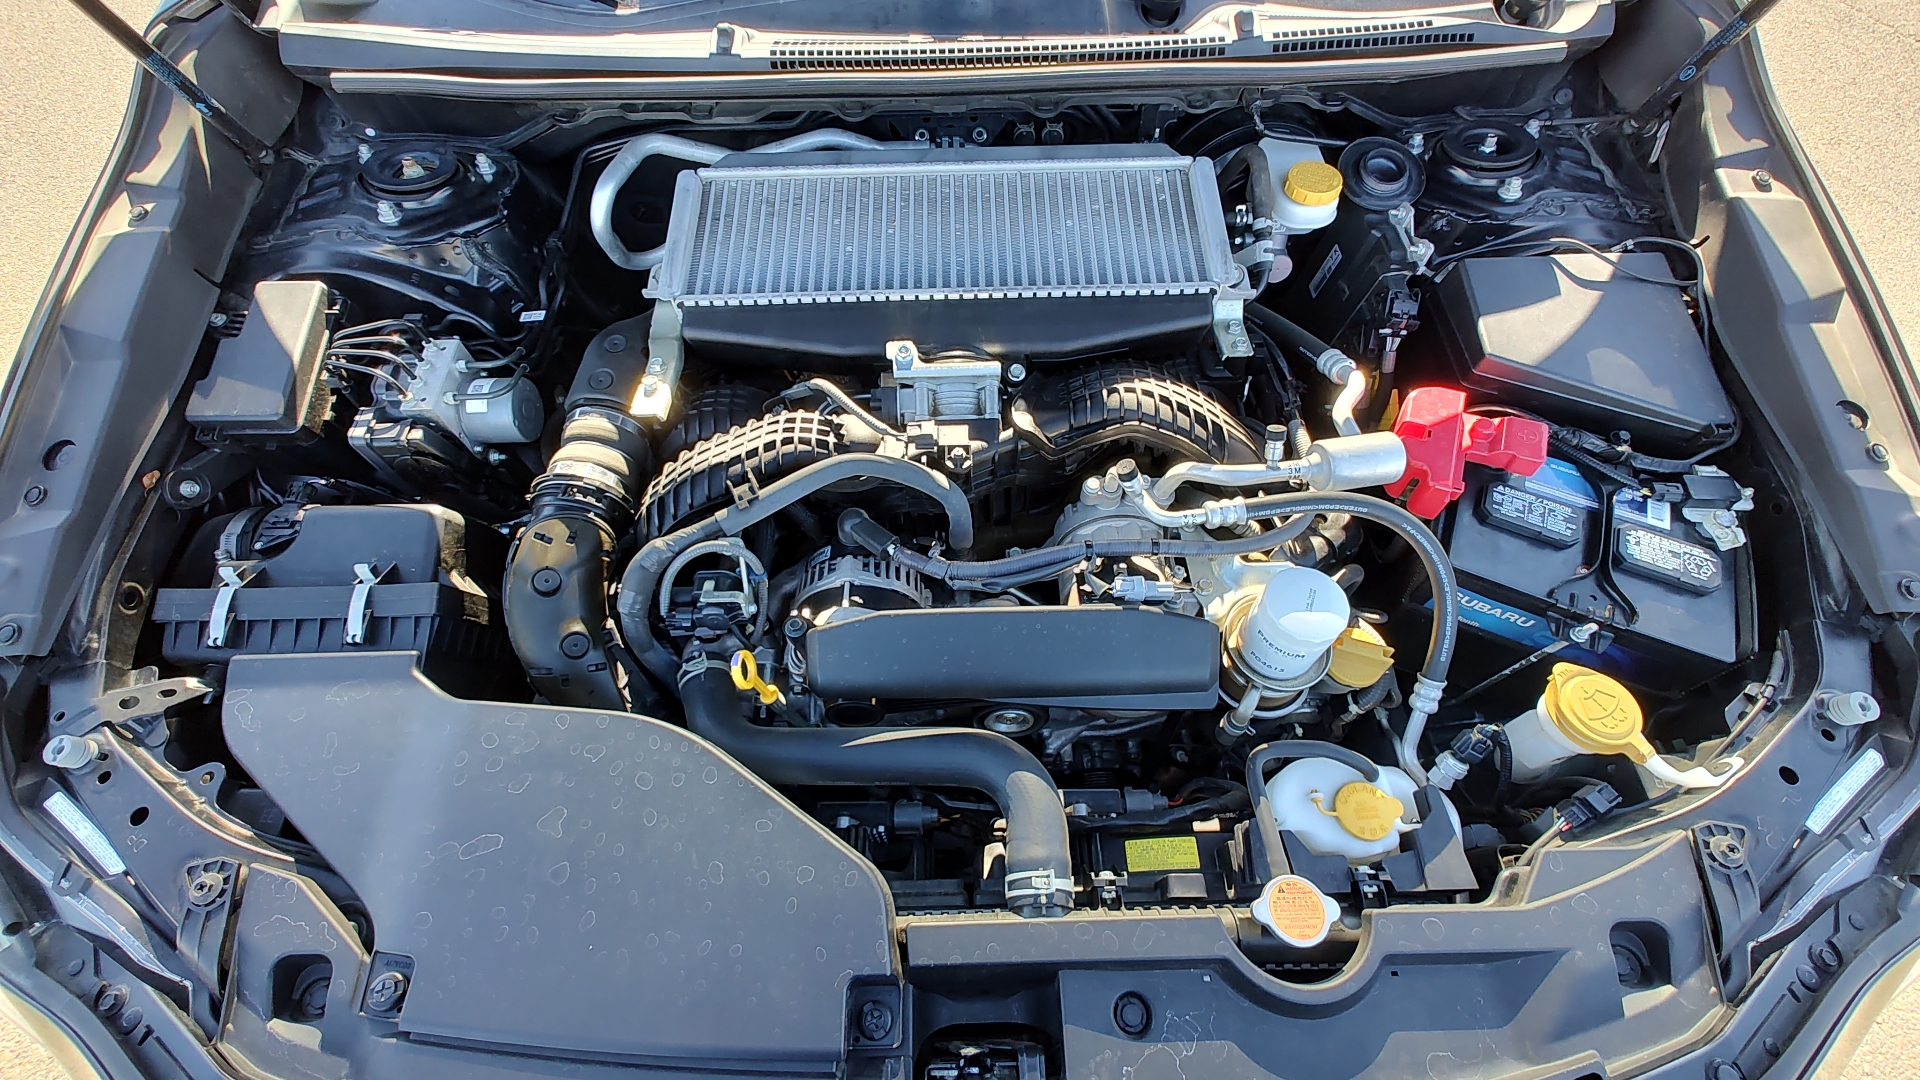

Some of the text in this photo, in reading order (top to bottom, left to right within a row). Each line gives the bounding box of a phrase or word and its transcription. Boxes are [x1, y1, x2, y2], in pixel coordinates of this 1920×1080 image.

[1550, 463, 1580, 476] SUBARU
[1503, 485, 1537, 502] DANGER
[1543, 500, 1573, 514] POISON
[1257, 629, 1306, 659] PREMIUM
